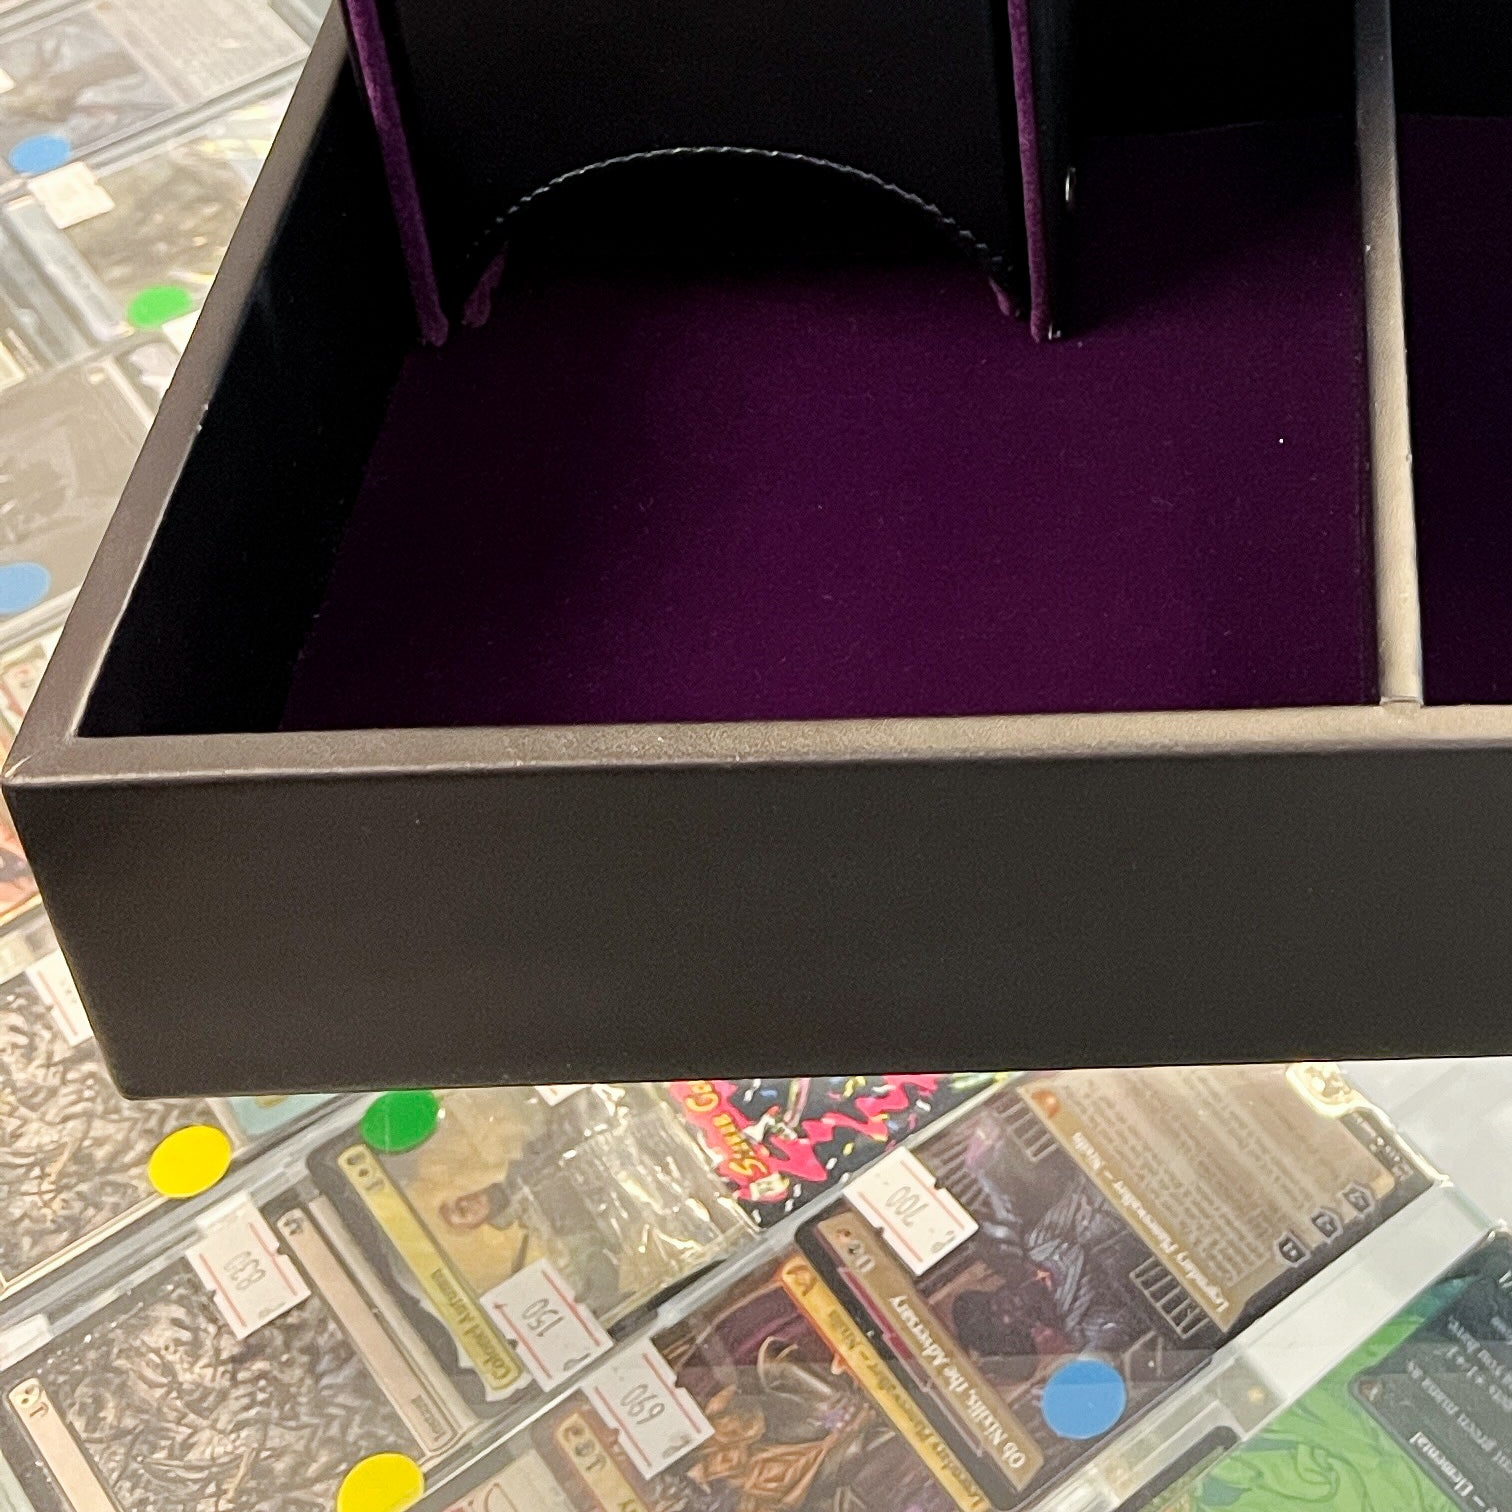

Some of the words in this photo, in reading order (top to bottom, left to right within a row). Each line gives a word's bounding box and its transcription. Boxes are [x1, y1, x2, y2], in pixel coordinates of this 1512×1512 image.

[884, 1179, 932, 1229] 700
[518, 1293, 565, 1340] 150
[884, 1288, 953, 1368] Adversary
[461, 1322, 512, 1384] Colonel
[937, 1361, 970, 1396] the
[1419, 1375, 1460, 1416] mana
[617, 1379, 667, 1429] 690
[998, 1439, 1028, 1471] Ob
[1454, 1409, 1498, 1453] green
[1408, 1429, 1474, 1498] Elemental
